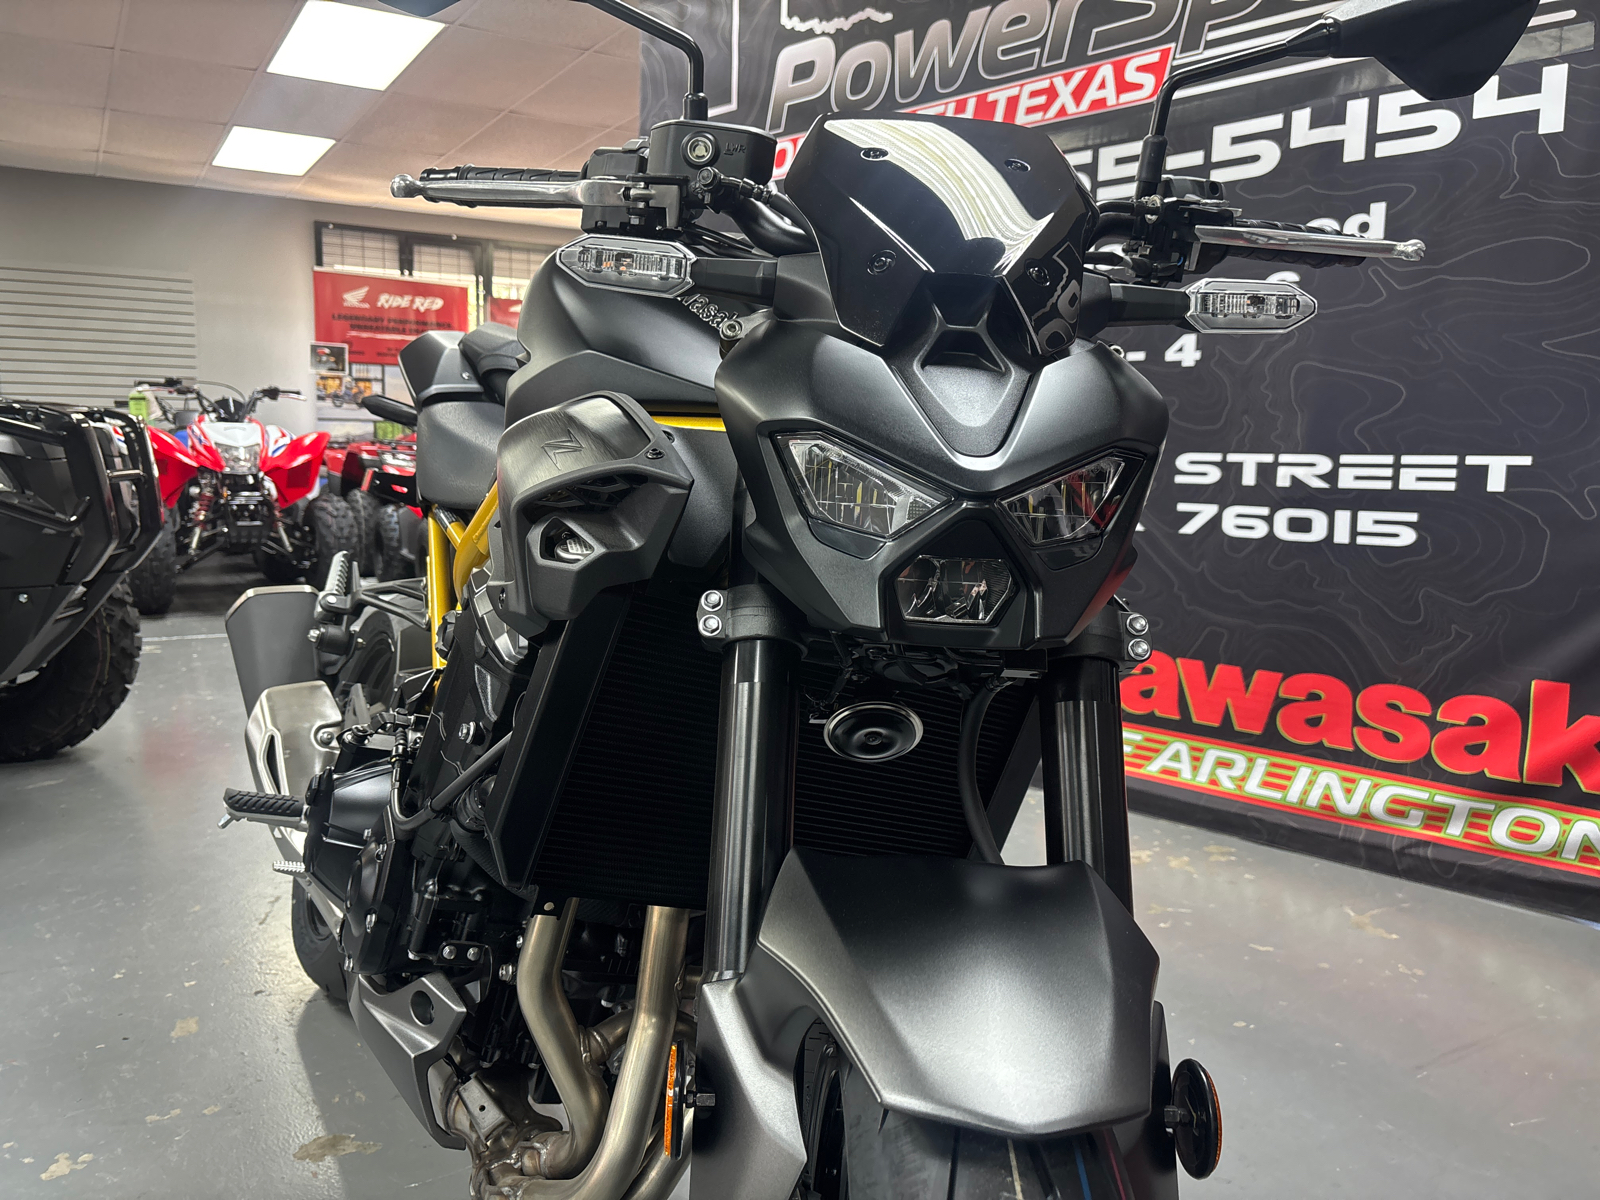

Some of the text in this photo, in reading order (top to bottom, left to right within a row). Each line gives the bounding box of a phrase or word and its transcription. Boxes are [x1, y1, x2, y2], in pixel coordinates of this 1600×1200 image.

[987, 51, 1162, 125] TEXAS
[376, 292, 444, 313] RIDE RED
[1164, 333, 1202, 368] 4
[1174, 452, 1533, 493] STREET
[1176, 502, 1420, 547] 76015
